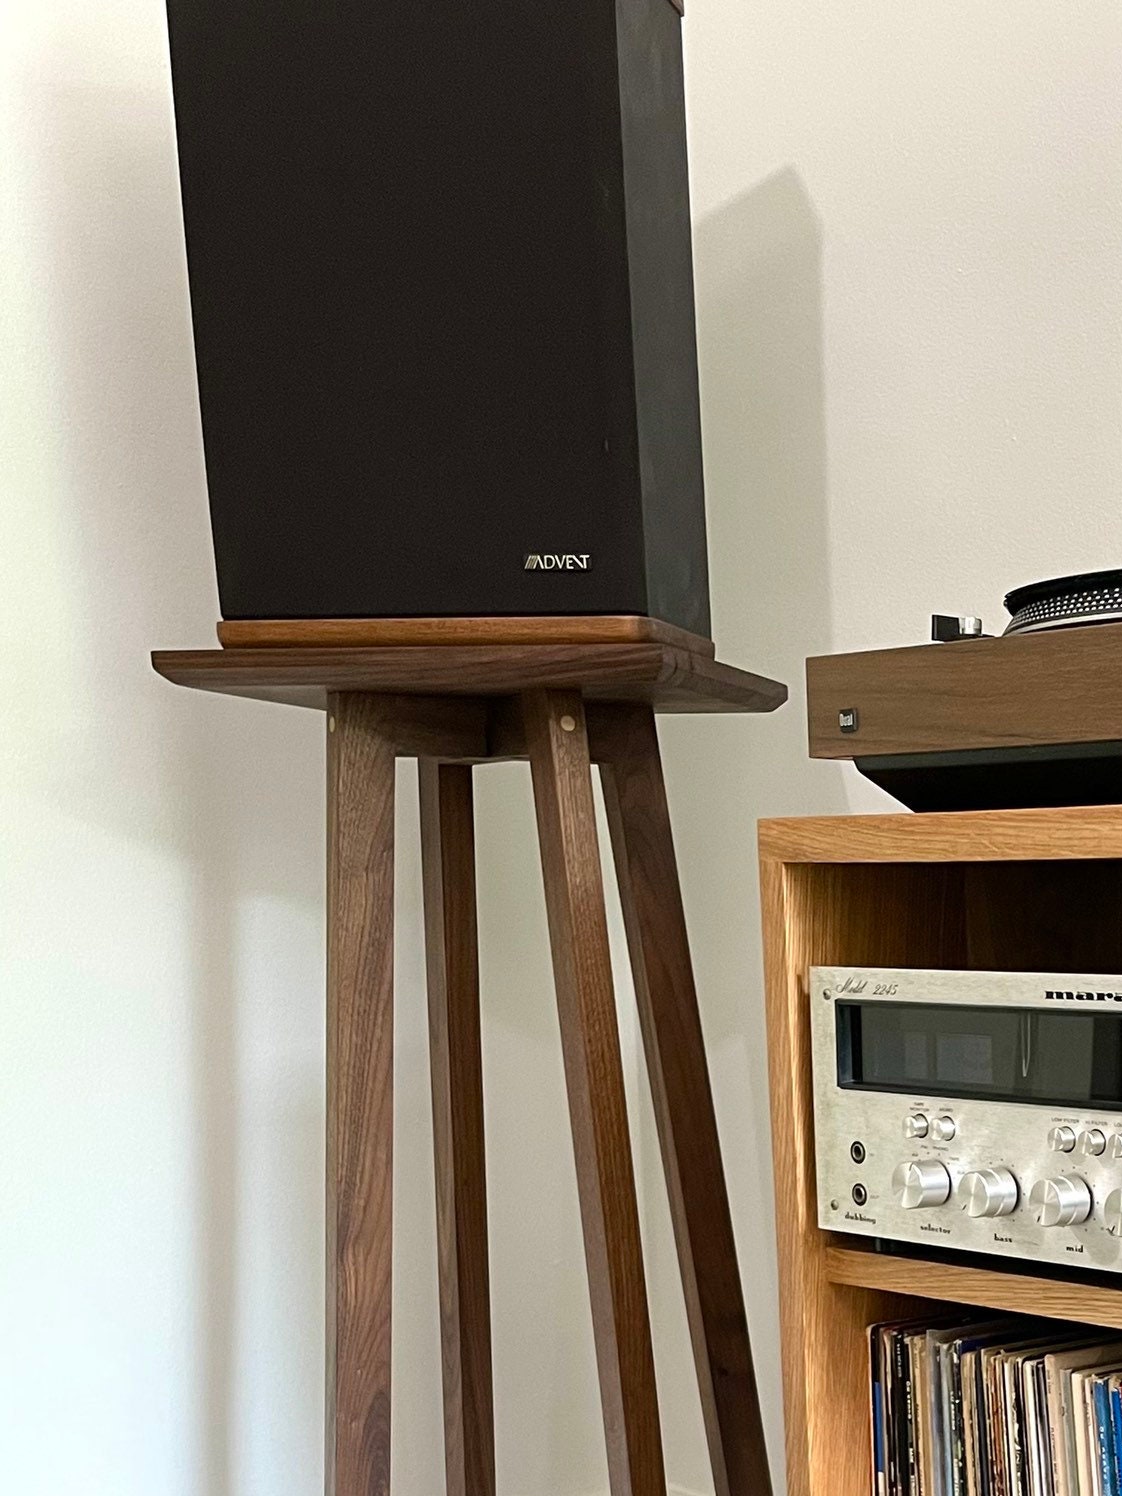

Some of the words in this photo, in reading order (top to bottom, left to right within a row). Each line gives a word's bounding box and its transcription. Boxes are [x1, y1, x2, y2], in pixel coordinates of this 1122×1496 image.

[524, 554, 590, 570] ADVENT
[839, 713, 853, 727] Dual
[835, 976, 868, 994] Model
[872, 983, 899, 996] 2245
[844, 1211, 877, 1225] dubbing
[920, 1224, 951, 1235] selector
[994, 1233, 1013, 1243] bass
[1066, 1244, 1084, 1253] mid
